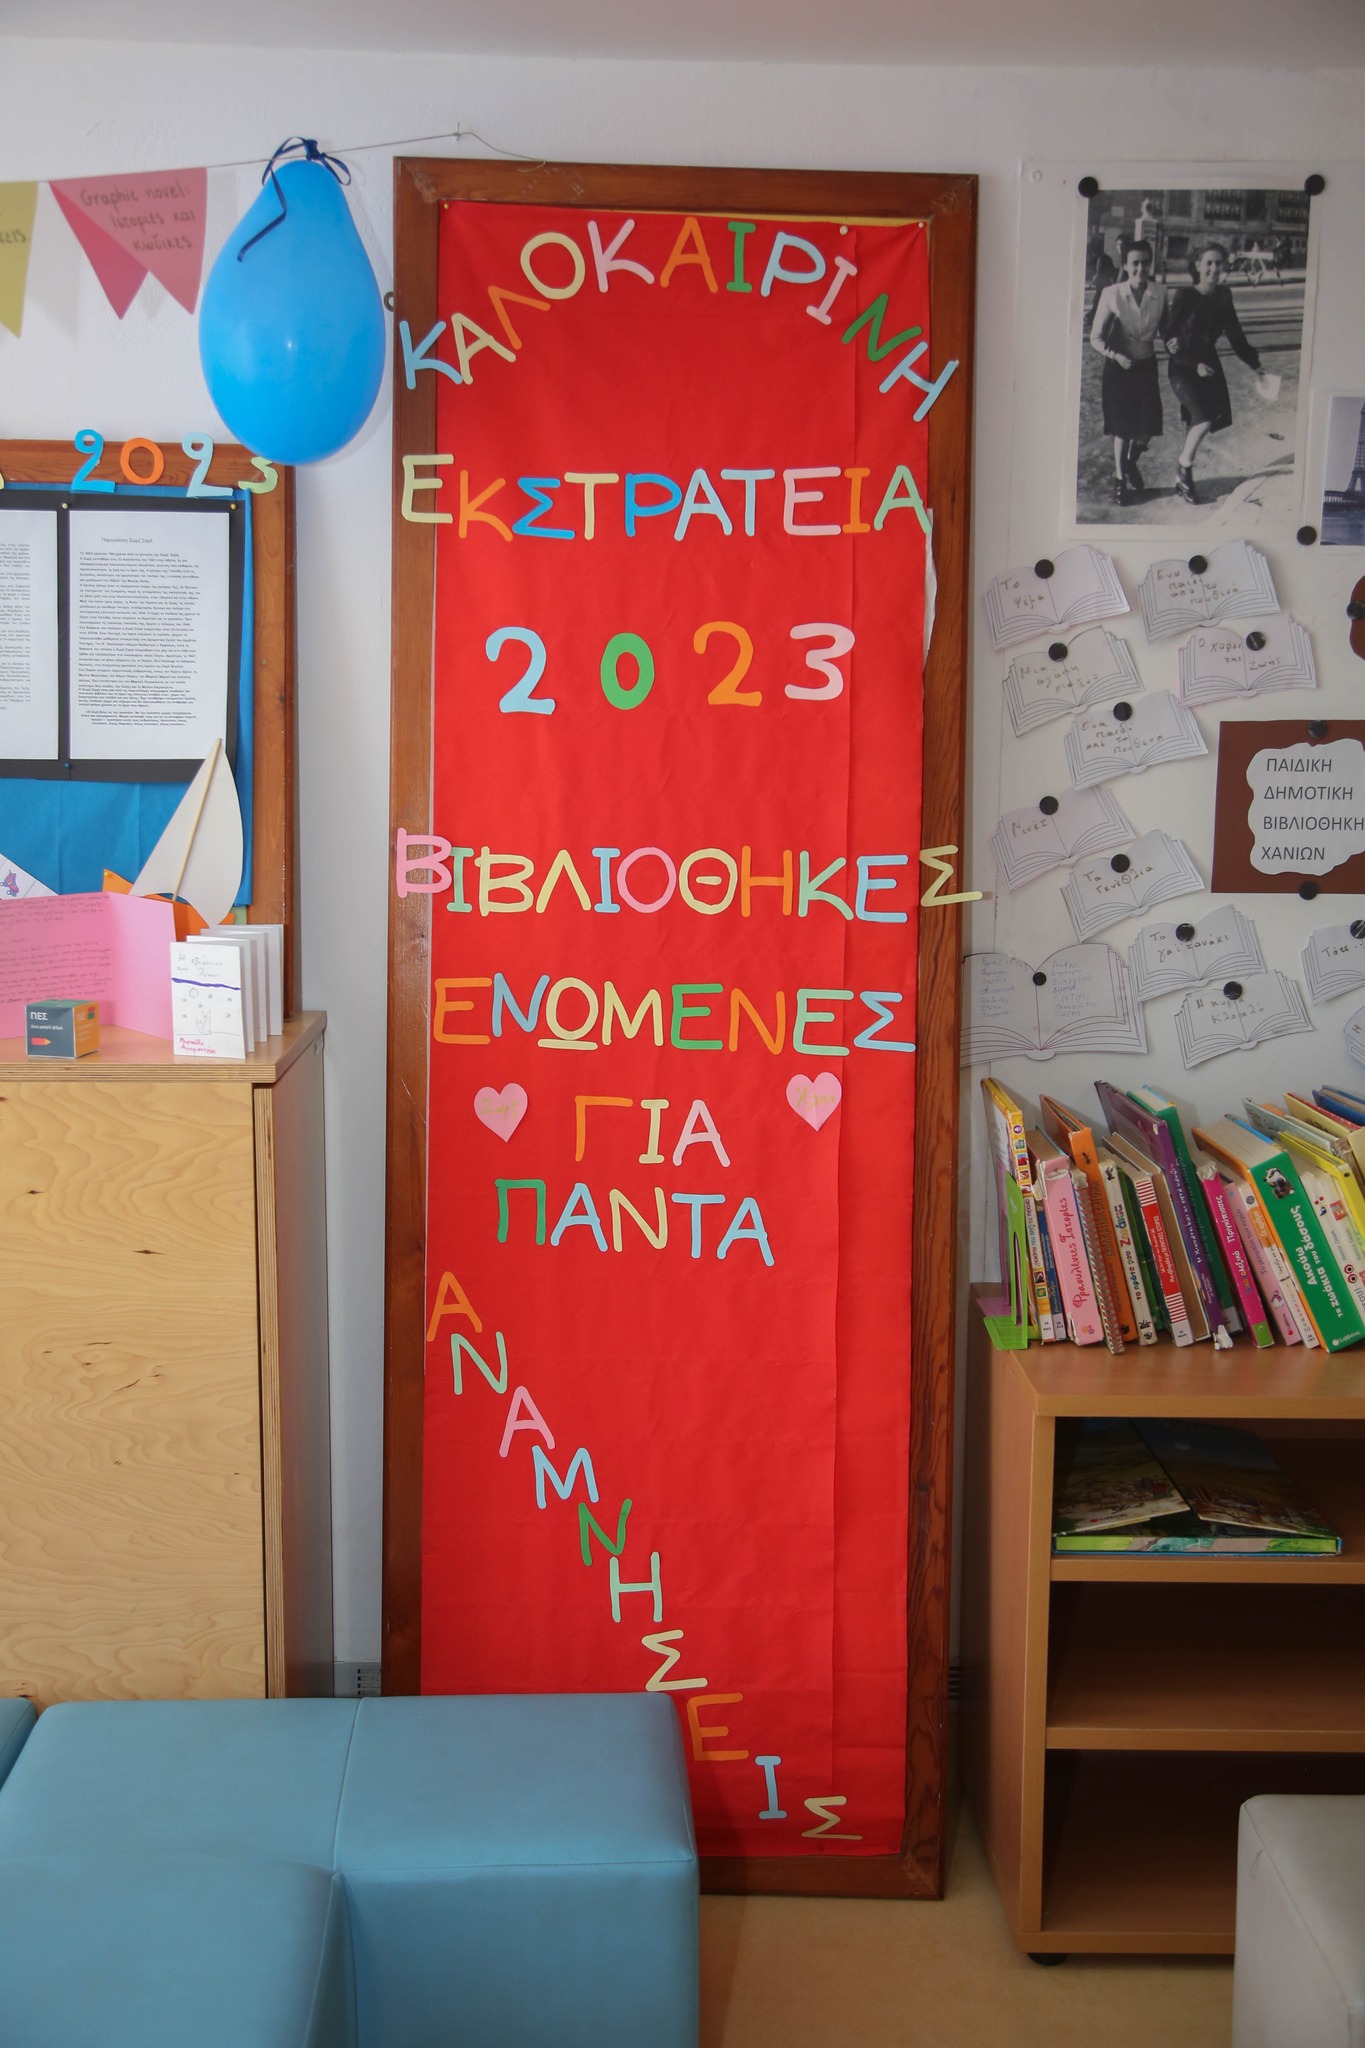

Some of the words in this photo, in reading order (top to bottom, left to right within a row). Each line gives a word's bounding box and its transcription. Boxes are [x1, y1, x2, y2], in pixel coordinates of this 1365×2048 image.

[80, 186, 139, 214] Graphic
[173, 210, 196, 223] και
[399, 217, 960, 423] ΚΑΛΟΚΑΙΡΙΝΗ
[400, 453, 932, 542] ΕΚΣΤΡΑΤΕΙΑ
[485, 621, 856, 715] 2023
[1266, 758, 1332, 772] ΠΑΙΔΙΚΗ
[1264, 786, 1353, 800] ΔΗΜΟΤΙΚΗ
[1263, 816, 1364, 831] ΒΙΒΛΙΟΘΗΚΗ
[1261, 846, 1325, 861] ΧΑΝΙΩΝ
[396, 827, 983, 923] ΒΙΒΛΙΟΘΗΚΕΣ
[30, 1011, 48, 1021] ΠΕΣ
[433, 972, 917, 1056] ΕΝΩΜΕΝΕΣ
[574, 1095, 731, 1167] ΓΙΑ
[494, 1178, 775, 1267] ΠΑΝΤΑ
[1058, 1197, 1075, 1243] Ιστορίες
[1215, 1195, 1236, 1243] Πριγκίπισσες
[1290, 1205, 1314, 1251] δάσους
[1070, 1242, 1091, 1309] Φραουλένιες
[1124, 1250, 1134, 1265] μου
[1127, 1265, 1140, 1290] πρώτα
[1297, 1247, 1316, 1286] Ακούω
[1311, 1251, 1322, 1264] του
[1135, 1291, 1141, 1300] τα
[1317, 1266, 1339, 1308] ζωάκια
[1335, 1307, 1344, 1318] τα
[426, 1270, 864, 1840] ΑΝΑΜΝΗΣΕΙΣ
